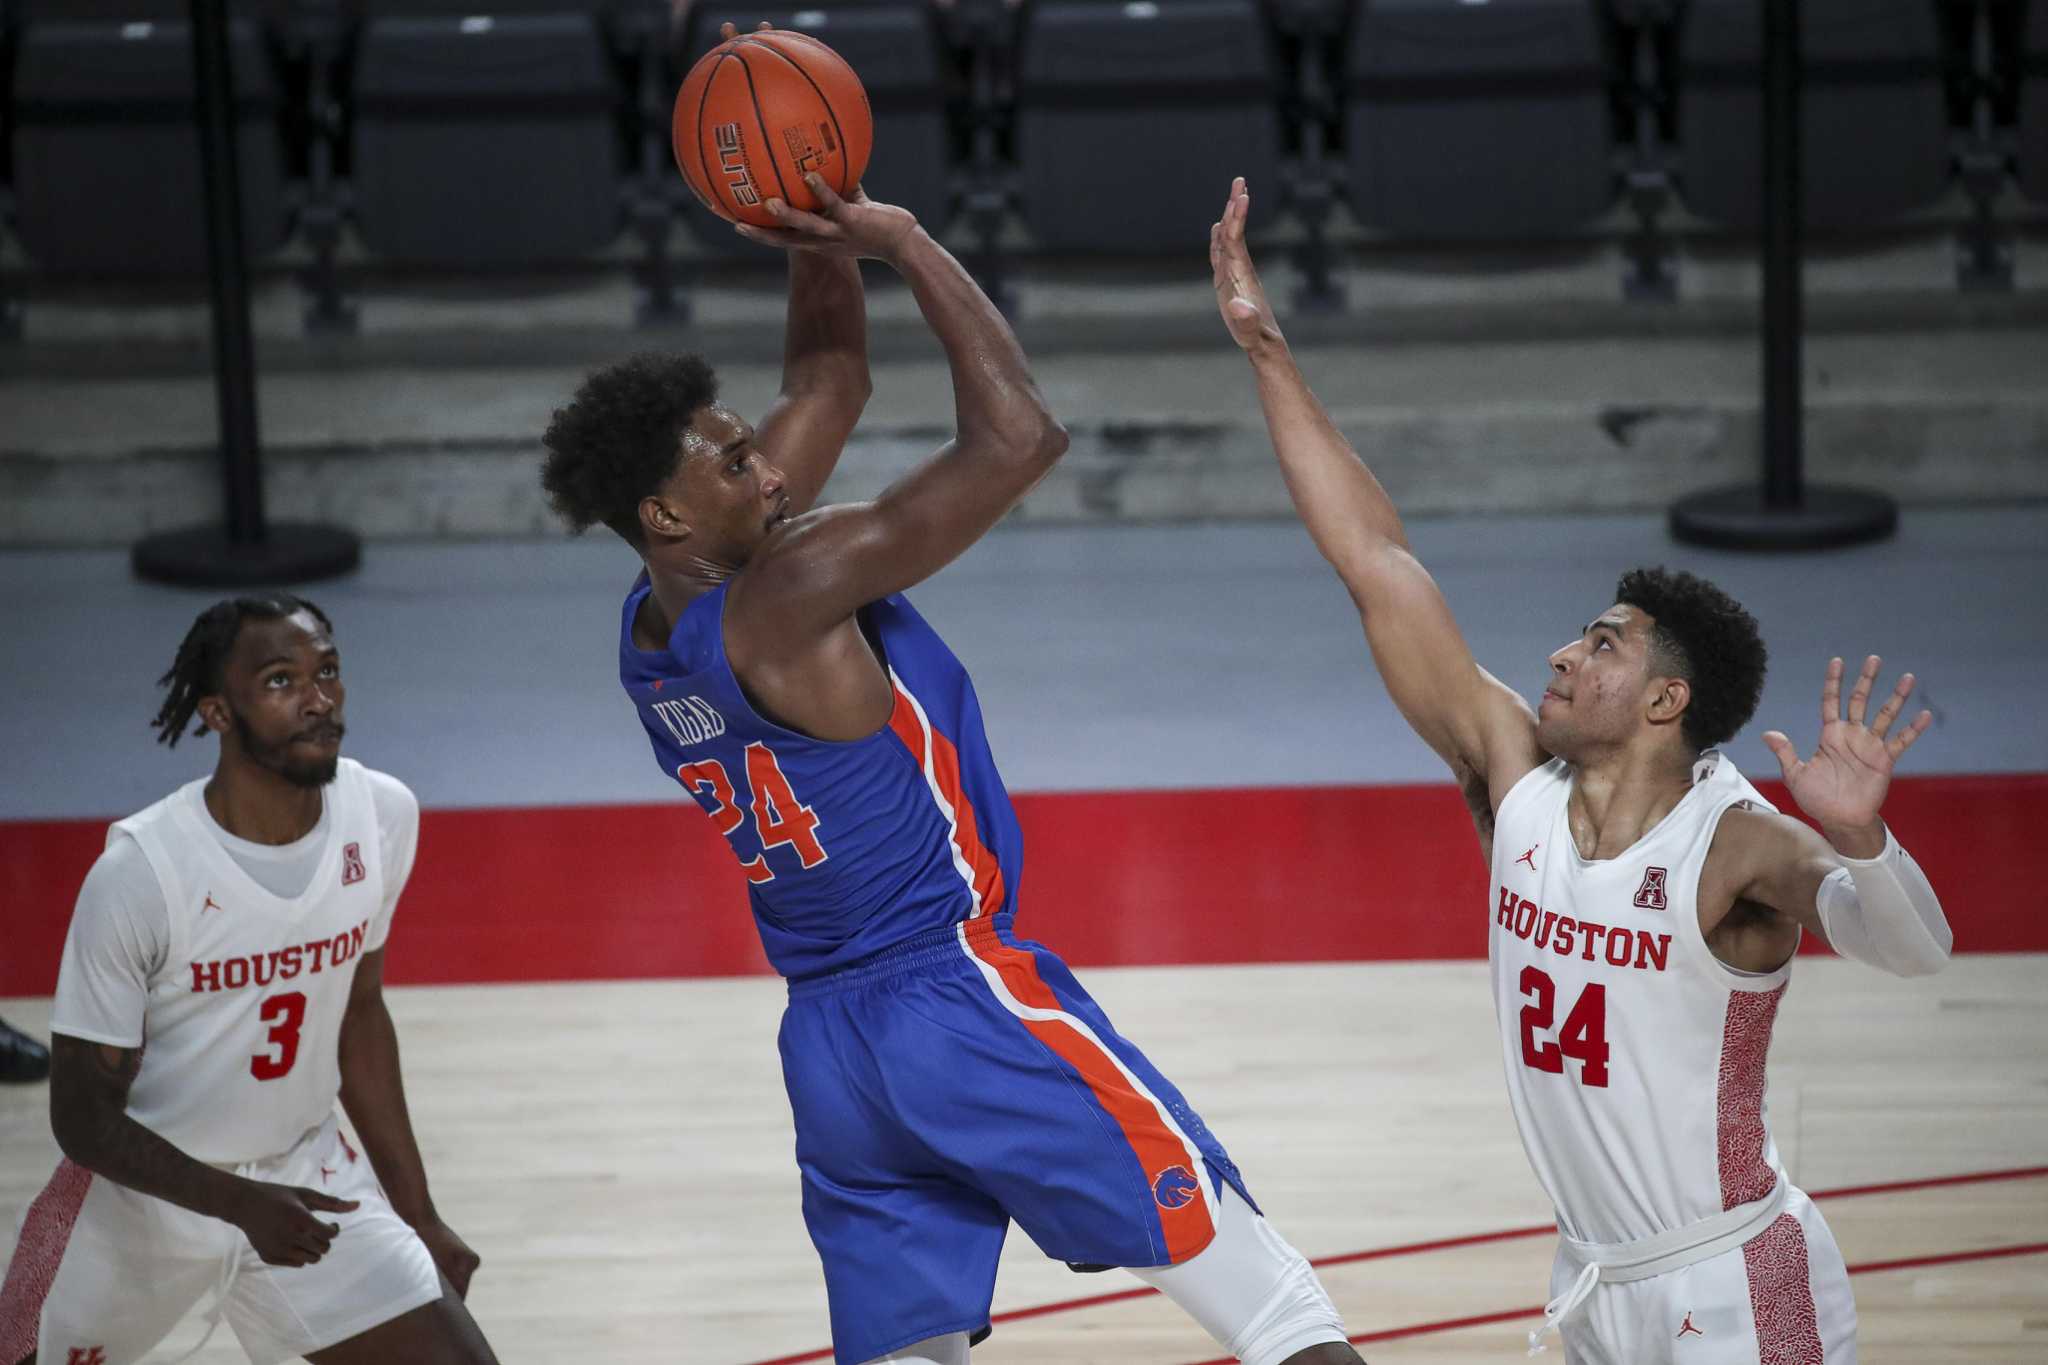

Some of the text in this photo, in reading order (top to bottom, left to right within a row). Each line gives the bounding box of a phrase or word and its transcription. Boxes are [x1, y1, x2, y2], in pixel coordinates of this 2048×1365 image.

[713, 123, 760, 207] ELITE
[651, 695, 726, 747] KIGAB
[677, 740, 829, 884] 24
[190, 919, 368, 993] HOUSTON
[1497, 886, 1672, 971] HOUSTON
[250, 992, 307, 1081] 3
[1519, 965, 1610, 1088] 24
